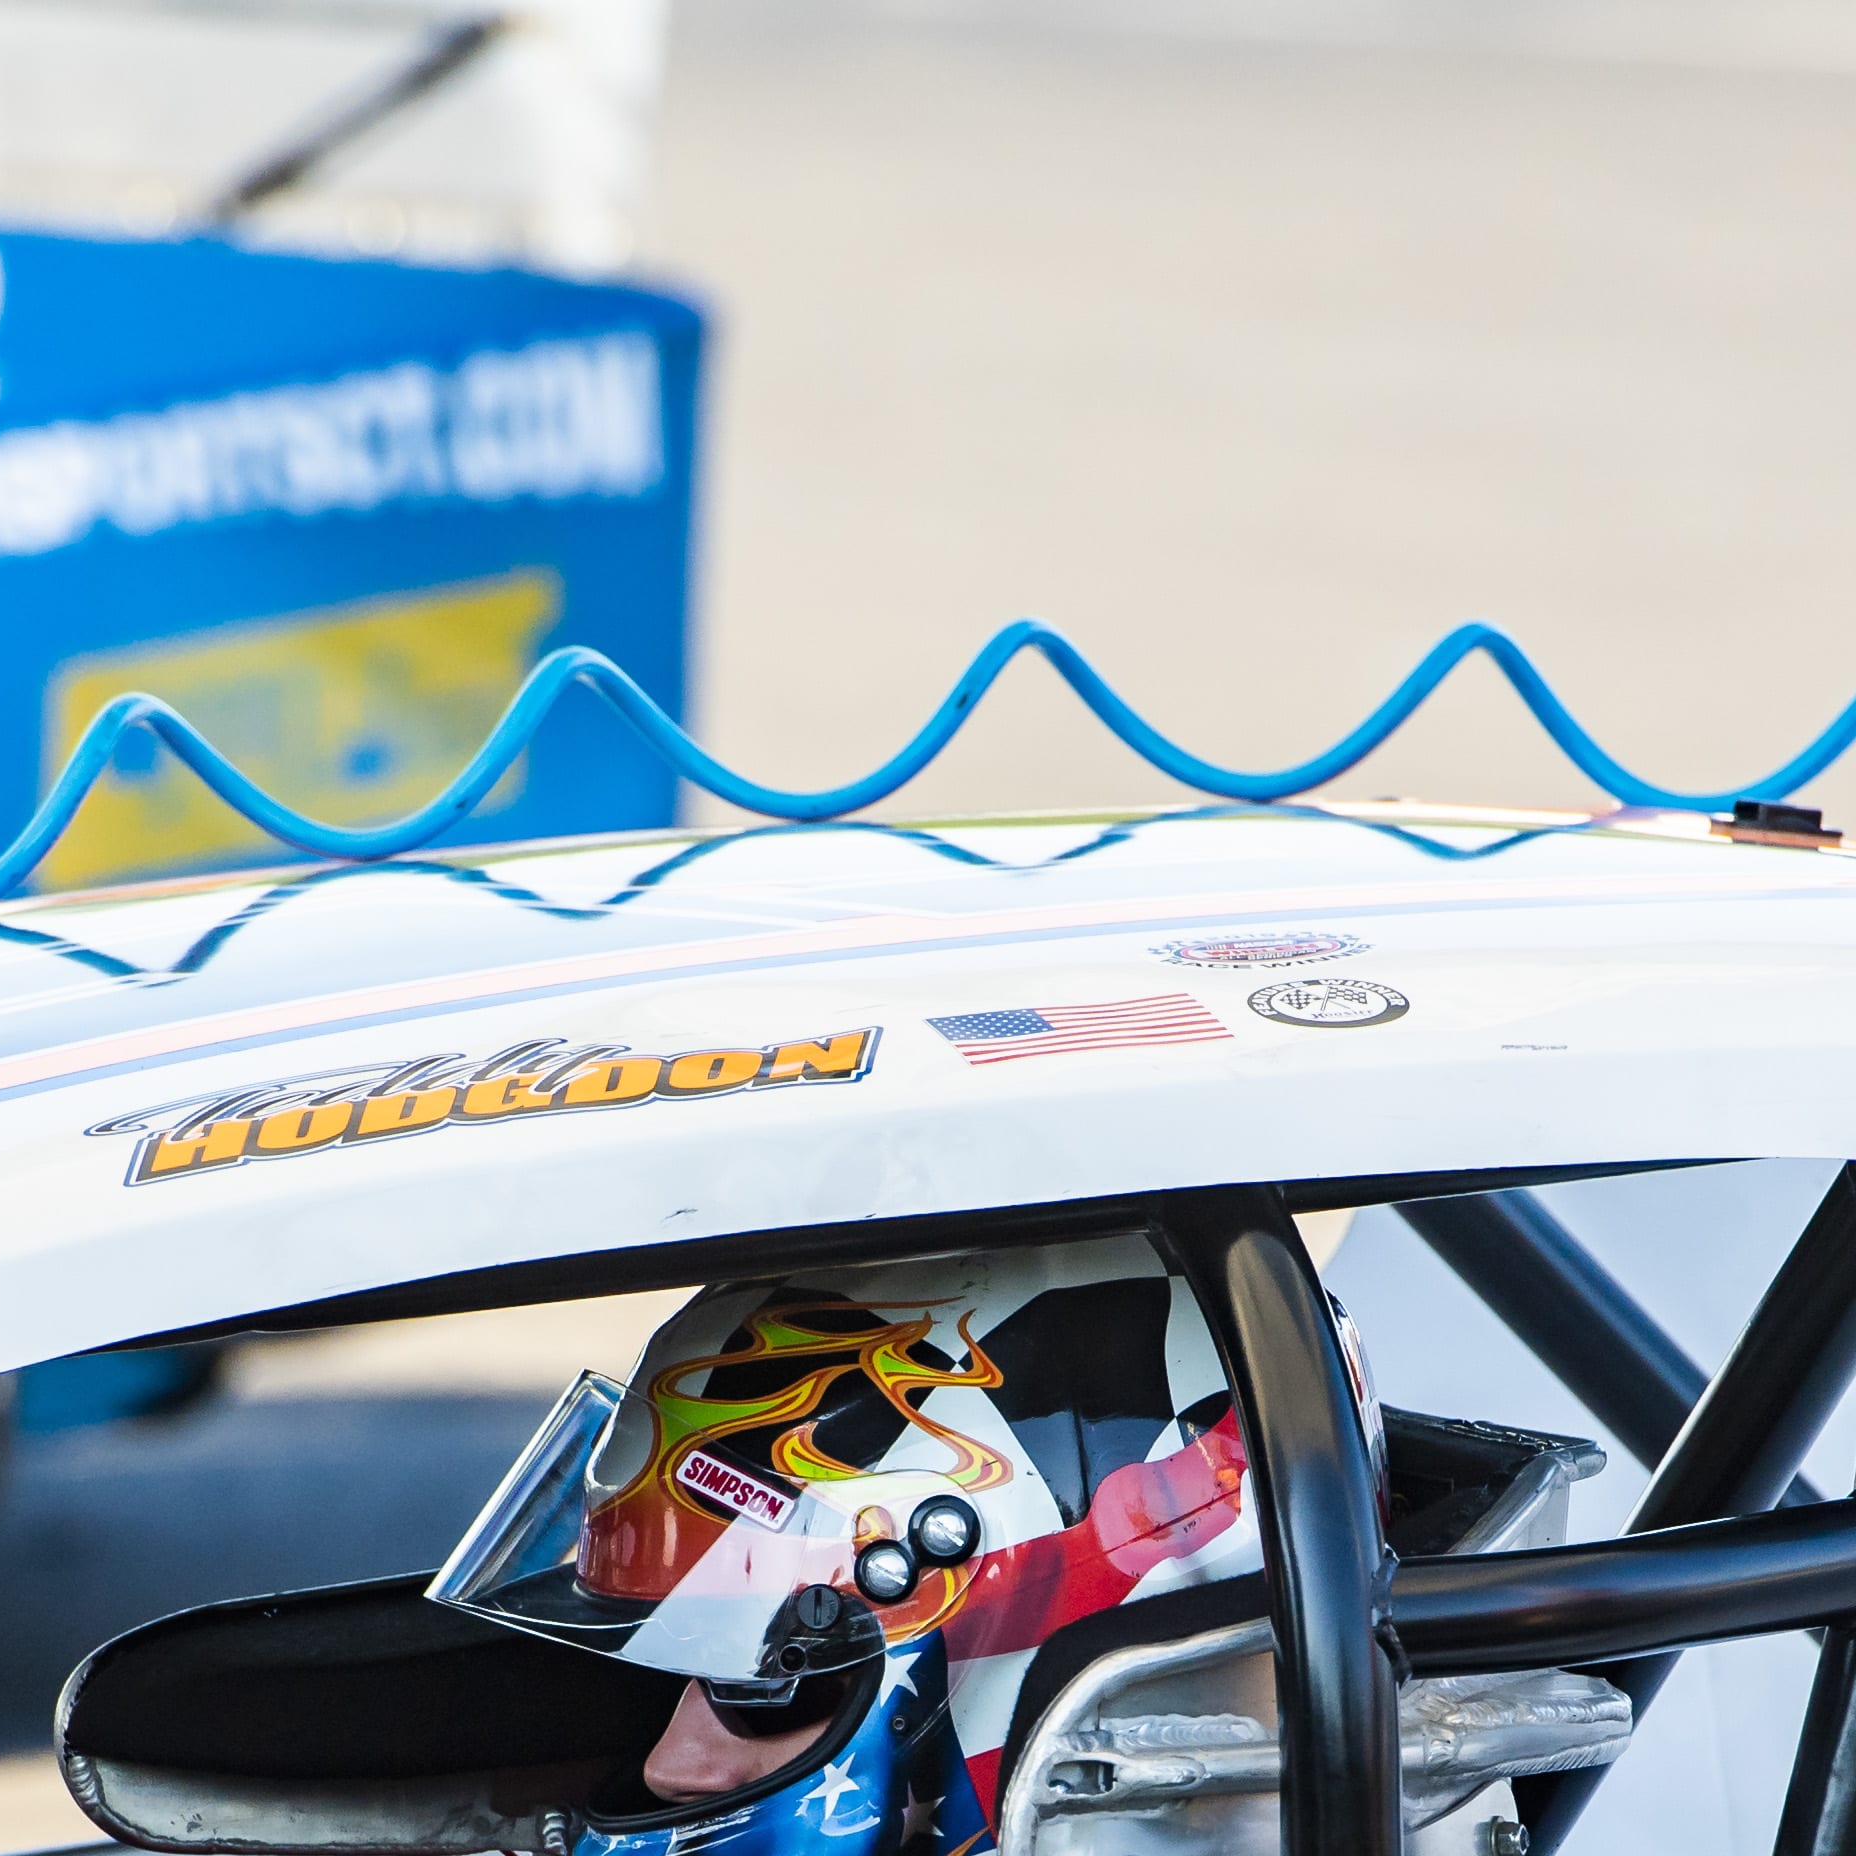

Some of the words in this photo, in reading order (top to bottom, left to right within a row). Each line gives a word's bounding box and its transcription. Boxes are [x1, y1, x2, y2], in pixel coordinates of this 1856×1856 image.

[1317, 978, 1407, 1007] WINNER
[124, 1025, 883, 1188] HODGDON
[684, 1456, 785, 1521] SIMPSON
